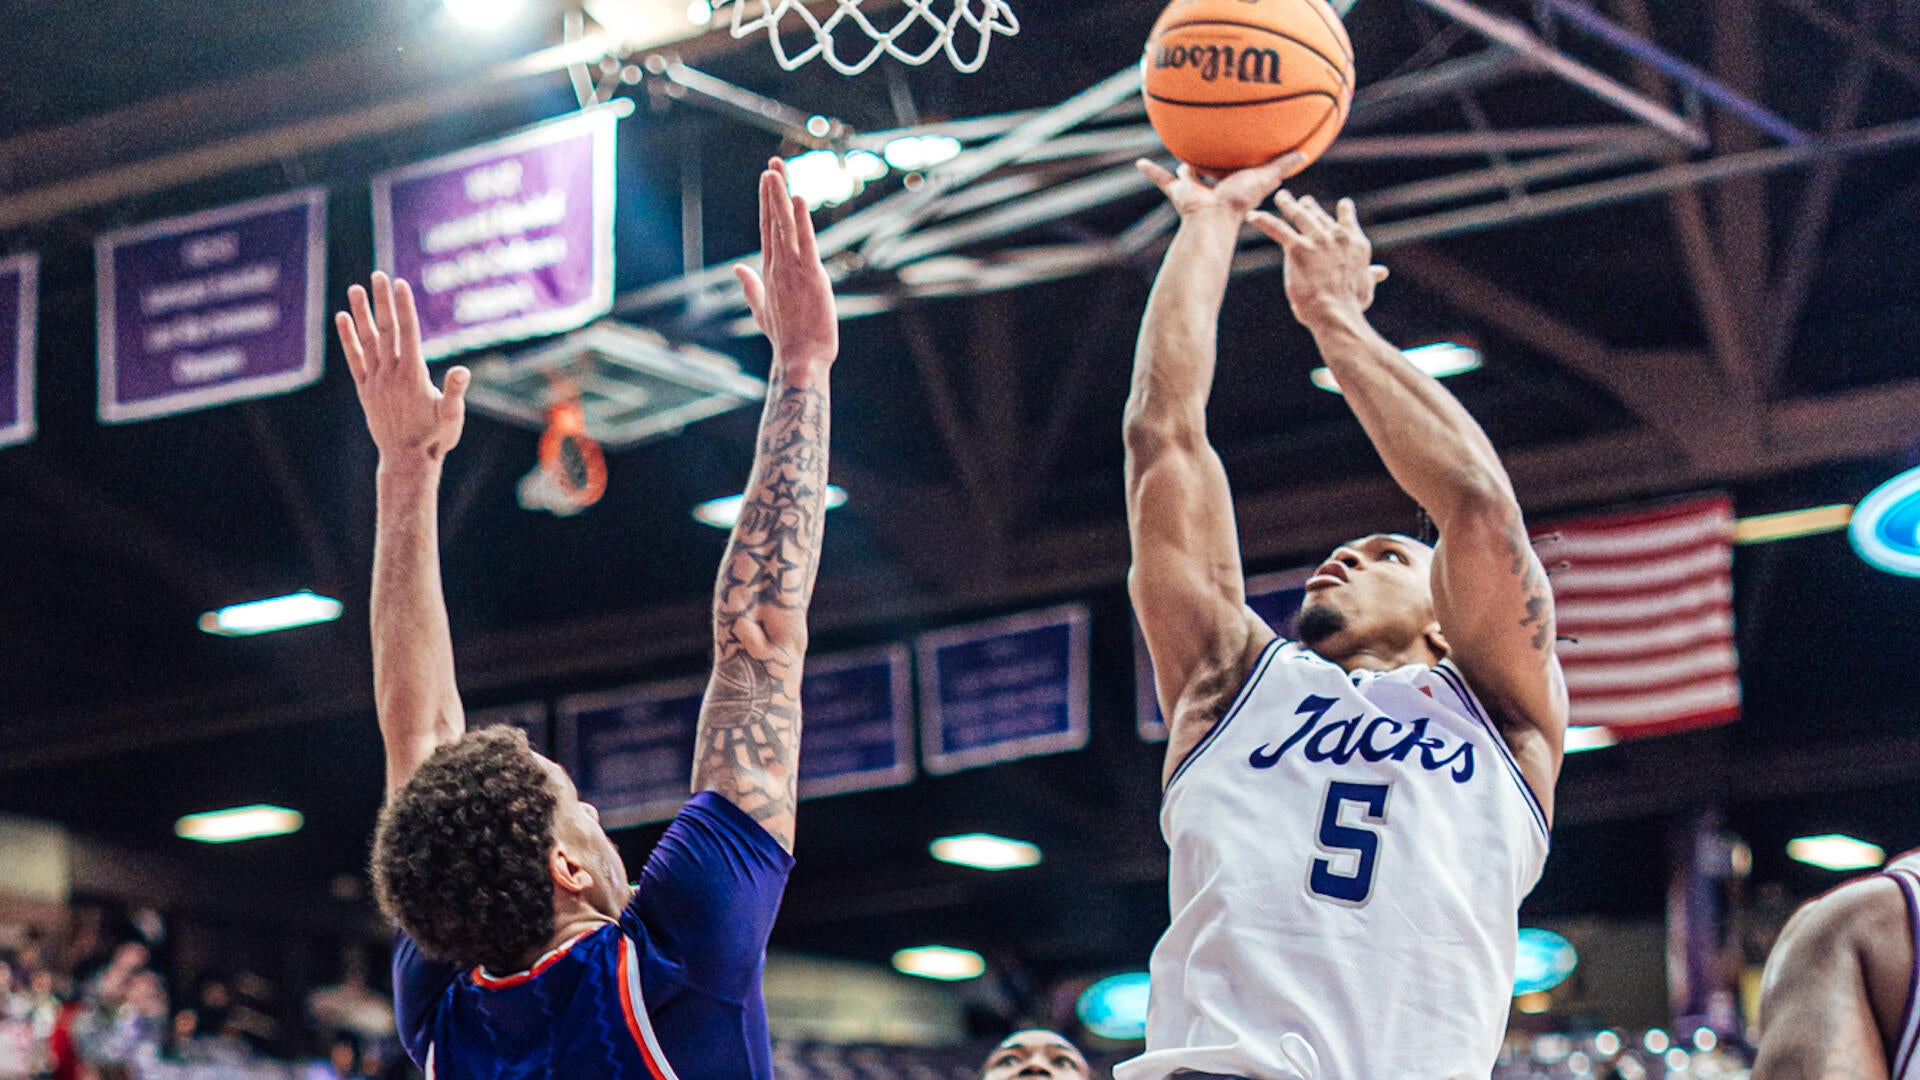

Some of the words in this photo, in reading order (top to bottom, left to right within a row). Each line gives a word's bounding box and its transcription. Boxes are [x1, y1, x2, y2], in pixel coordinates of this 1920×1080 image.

[1154, 44, 1282, 84] Wilson
[1249, 693, 1475, 784] Jacks
[1306, 778, 1392, 907] 5
